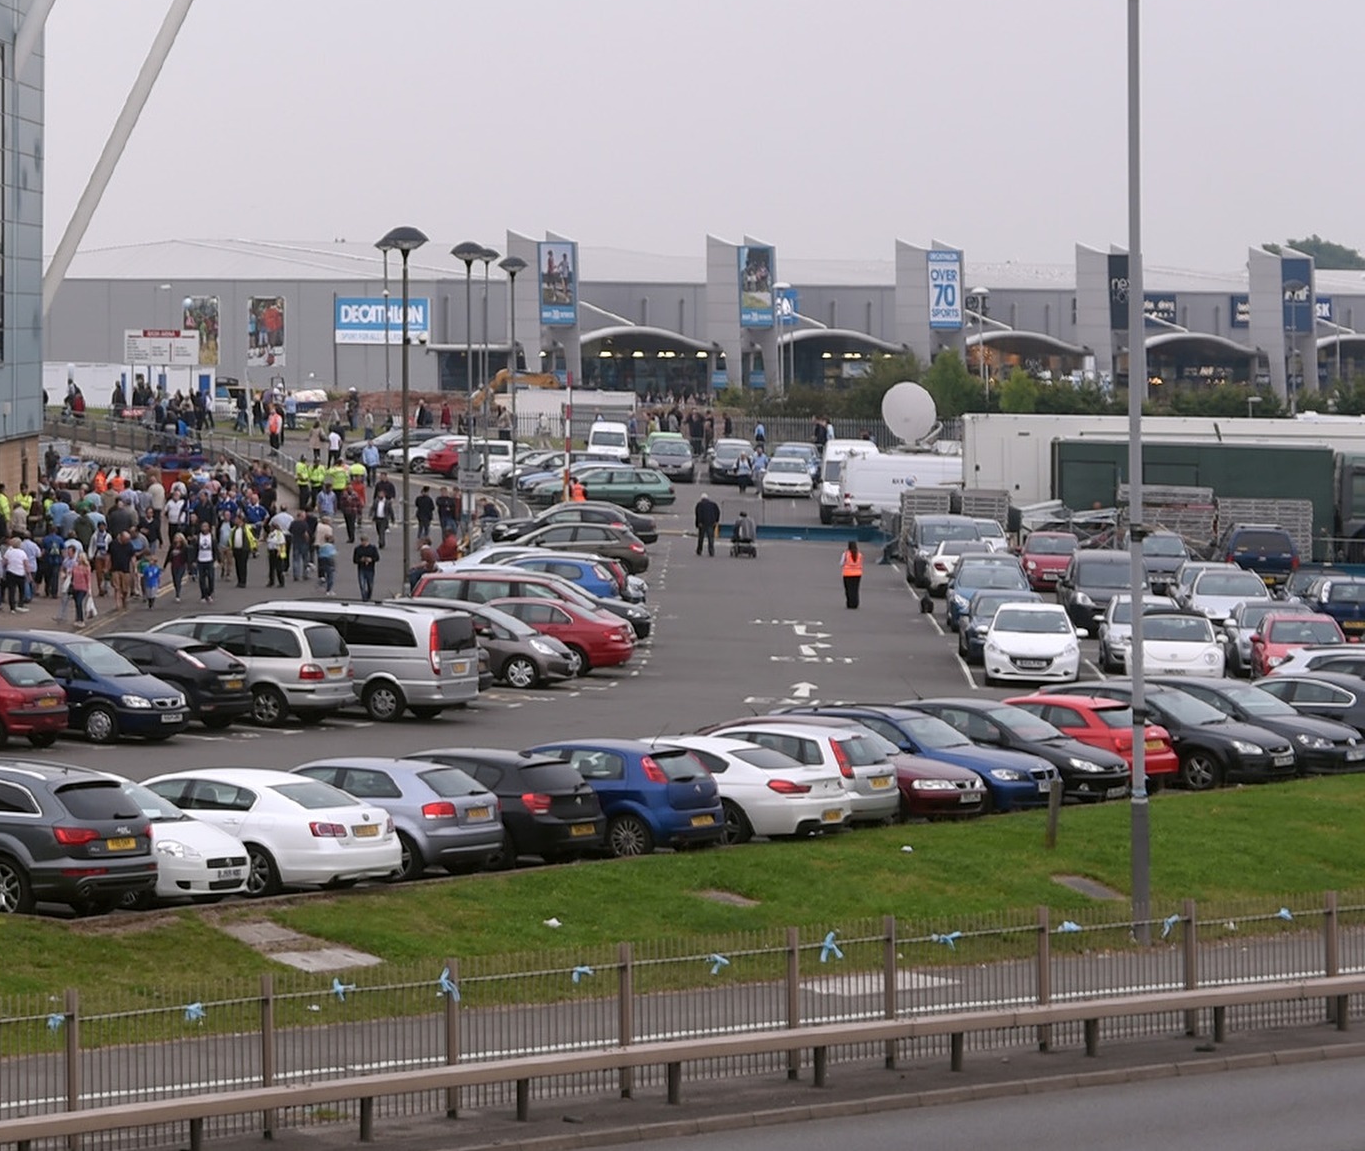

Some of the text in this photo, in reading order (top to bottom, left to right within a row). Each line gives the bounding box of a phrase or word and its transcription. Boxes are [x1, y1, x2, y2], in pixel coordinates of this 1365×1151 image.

[930, 269, 957, 281] OVER
[933, 283, 955, 306] 70
[340, 304, 423, 324] DECATHLON
[931, 308, 959, 317] SPORTS
